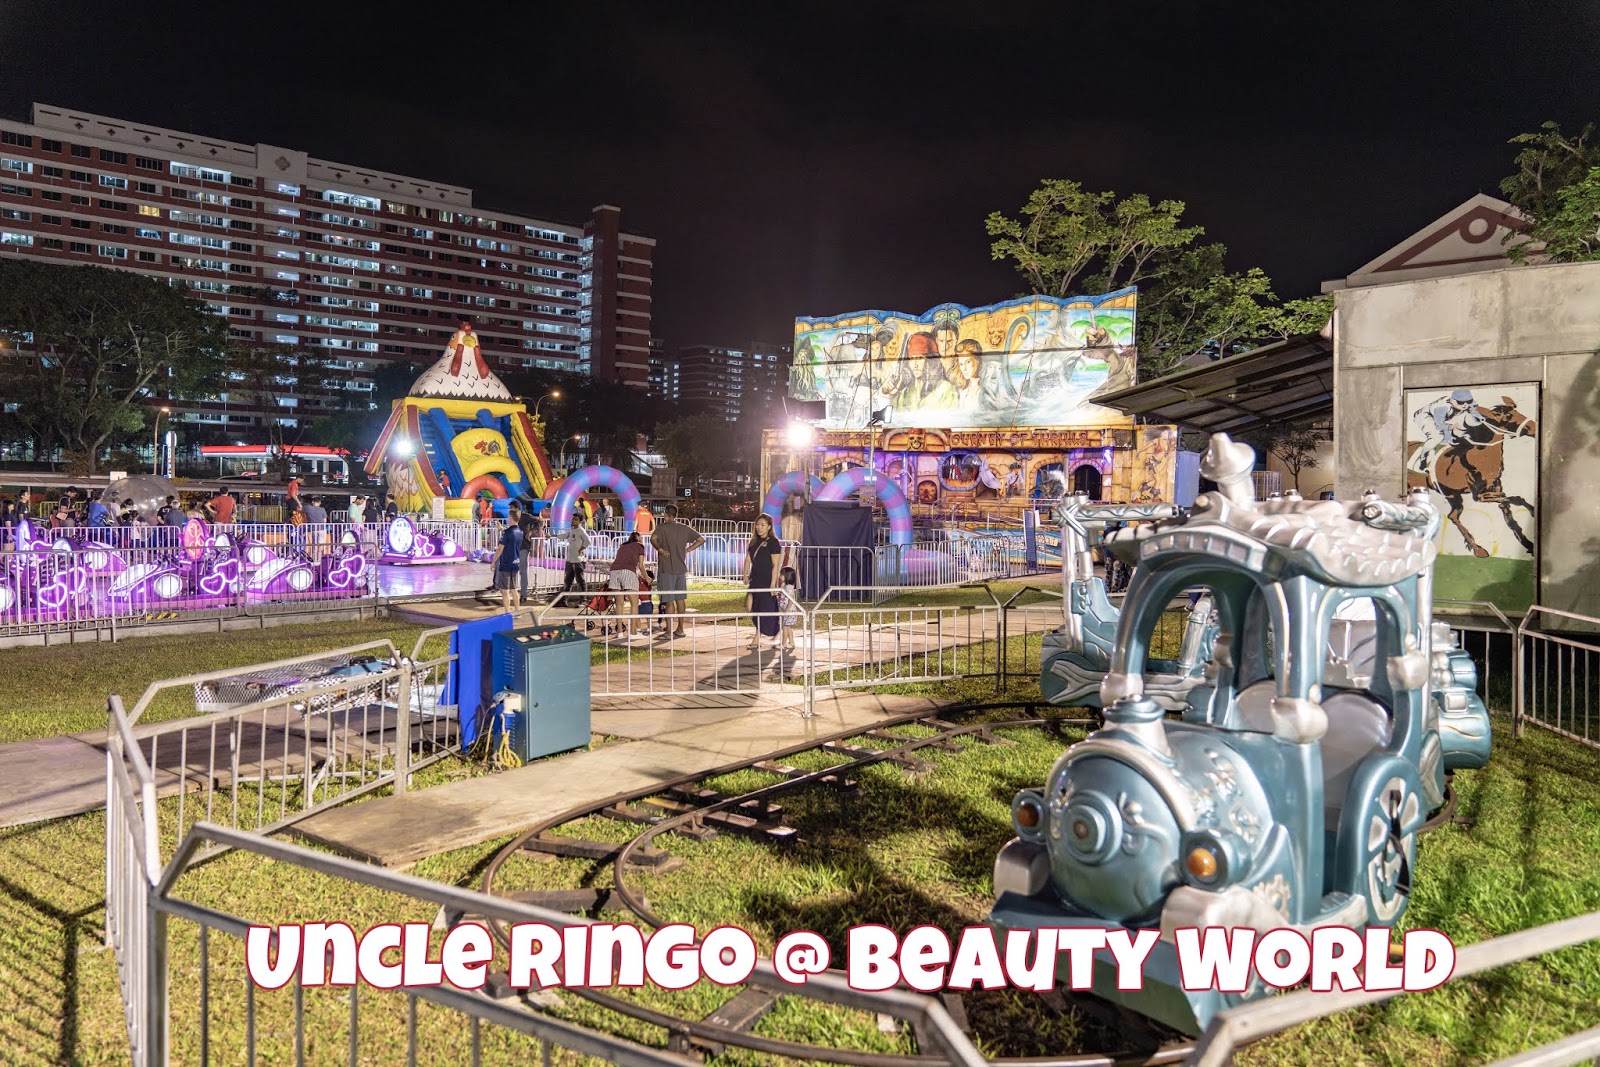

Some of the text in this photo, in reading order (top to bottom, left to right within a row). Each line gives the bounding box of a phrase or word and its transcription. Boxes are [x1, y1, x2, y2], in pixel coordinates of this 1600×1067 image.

[945, 431, 1087, 447] JOURNEY OF THRILLS
